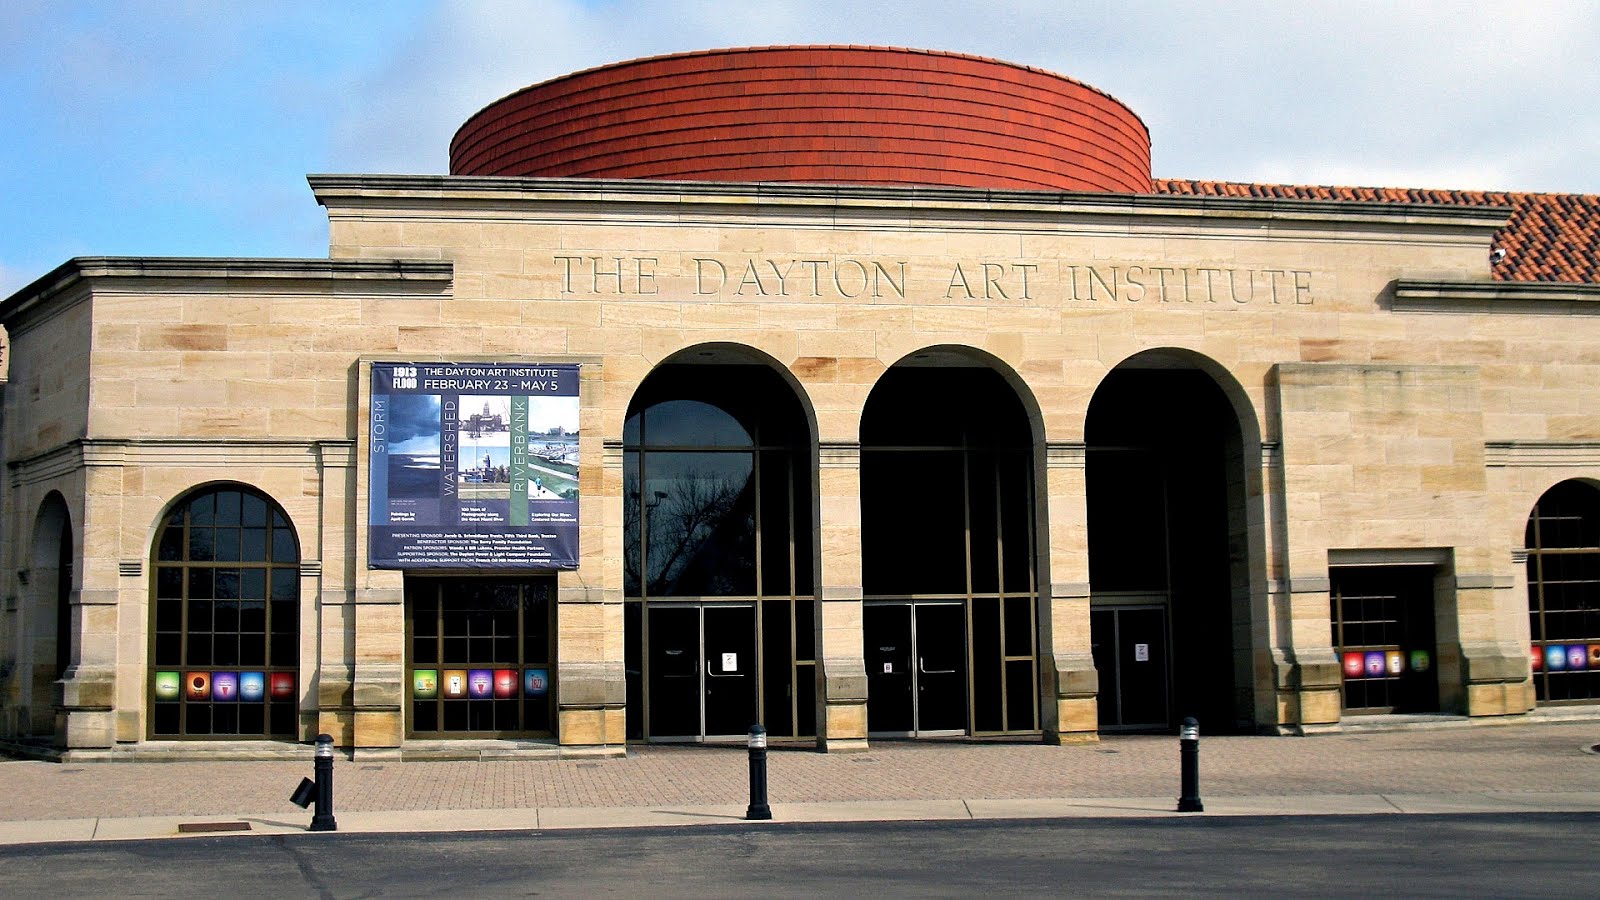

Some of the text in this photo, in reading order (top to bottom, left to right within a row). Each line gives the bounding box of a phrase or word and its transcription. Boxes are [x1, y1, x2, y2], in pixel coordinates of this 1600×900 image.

[553, 256, 1314, 305] THE DAYTON ART INSTITUTE
[392, 378, 417, 389] FLOOD
[393, 367, 417, 377] 1913
[424, 368, 558, 377] THE DAYTON ART INSTITUTE
[424, 380, 491, 389] FEBRUARY
[494, 380, 509, 390] 23
[521, 381, 547, 390] MAY
[550, 381, 558, 390] 5
[373, 400, 385, 453] STORM
[444, 401, 456, 496] WATERSHED
[513, 401, 525, 492] RIVERBANK
